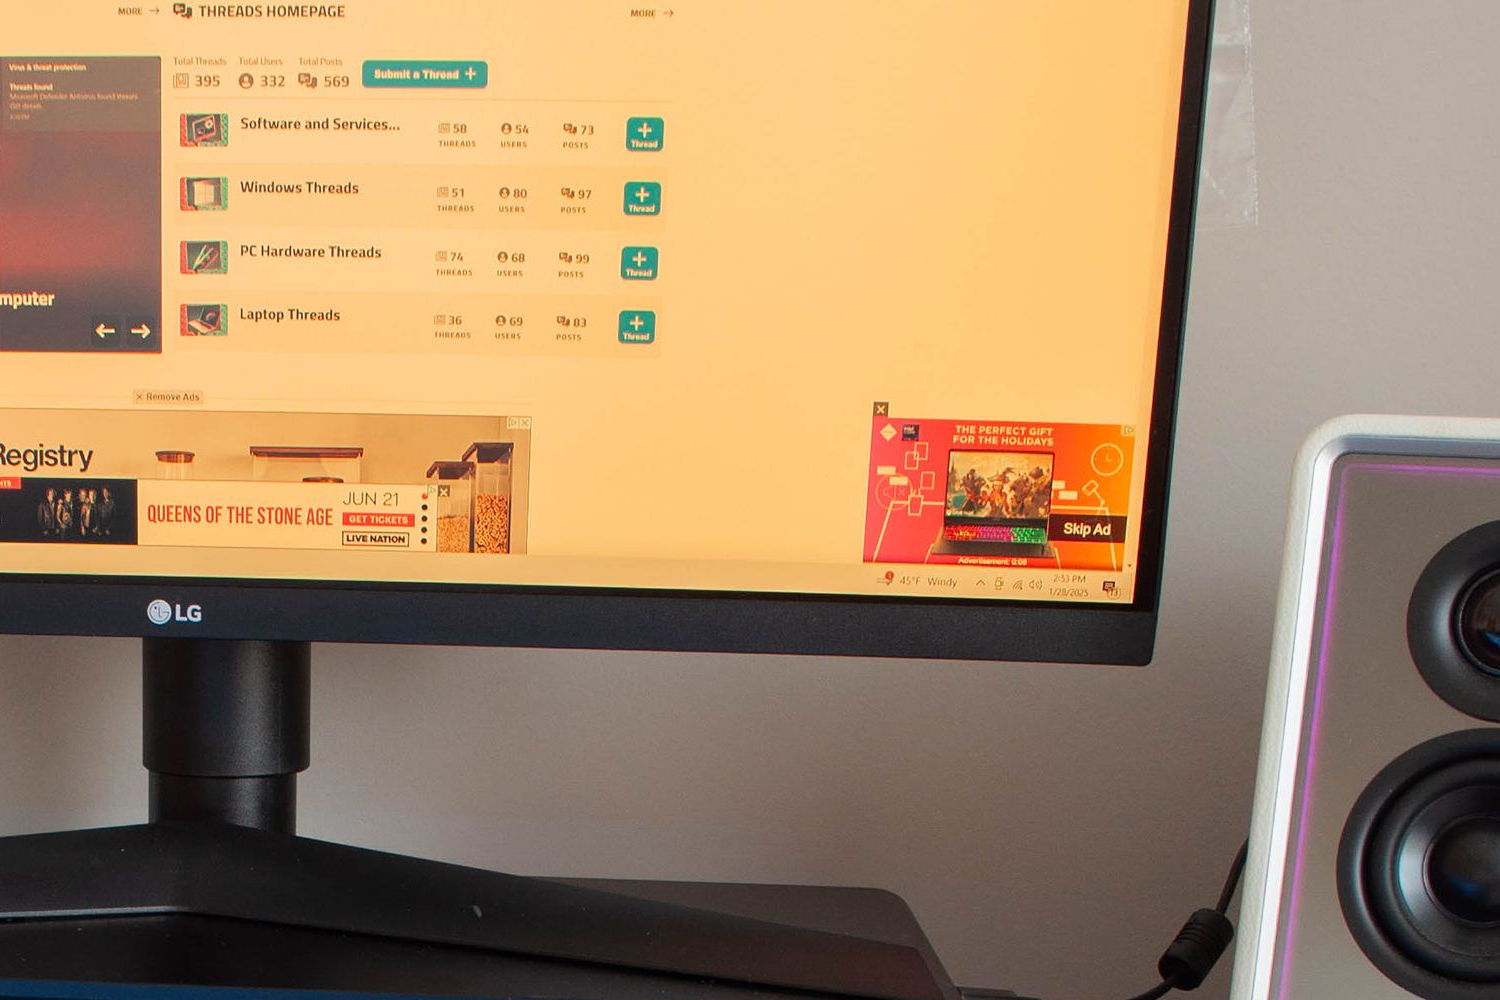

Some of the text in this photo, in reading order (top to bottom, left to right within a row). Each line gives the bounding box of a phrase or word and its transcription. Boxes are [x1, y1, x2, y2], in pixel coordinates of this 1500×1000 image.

[118, 7, 143, 15] MORE
[199, 5, 345, 18] THREADS HOMEPAGE
[630, 9, 656, 18] MORE
[260, 58, 283, 66] Users
[299, 58, 343, 66] Total Posts
[374, 69, 459, 80] Submit a Thread
[195, 76, 220, 87] 395
[260, 76, 285, 87] 332
[324, 76, 349, 87] 569
[240, 117, 401, 132] Software and Services...
[453, 125, 467, 133] 58
[515, 125, 529, 134] 54
[580, 126, 594, 135] 73
[630, 139, 658, 148] Thread
[240, 181, 359, 195] Windows Threads
[452, 189, 464, 197] 51
[513, 189, 527, 198] 80
[578, 190, 591, 199] 97
[561, 206, 587, 214] POSTS
[628, 204, 655, 213] Thread
[240, 245, 382, 259] PC Hardware Threads
[450, 252, 463, 261] 74
[511, 253, 525, 262] 68
[576, 254, 590, 263] 99
[558, 270, 584, 278] POSTS
[625, 268, 653, 278] Thread
[240, 309, 340, 324] Laptop Threads
[448, 316, 462, 325] 36
[509, 317, 523, 326] 69
[573, 318, 587, 328] 83
[495, 332, 521, 340] USERS
[622, 332, 650, 341] Thread
[146, 392, 200, 402] Remove Ads
[956, 425, 1053, 436] THE PERFECT GIFT
[953, 435, 1053, 446] FOR THE HOLIDAYS
[343, 492, 400, 507] JUN 21
[147, 506, 333, 526] QUEENS OF THE STONE AGE
[349, 515, 408, 525] GET TICKETS
[1063, 523, 1111, 536] Skip Ad
[346, 535, 405, 544] LIVE NATION
[927, 578, 957, 588] Windy
[176, 604, 201, 622] LG
